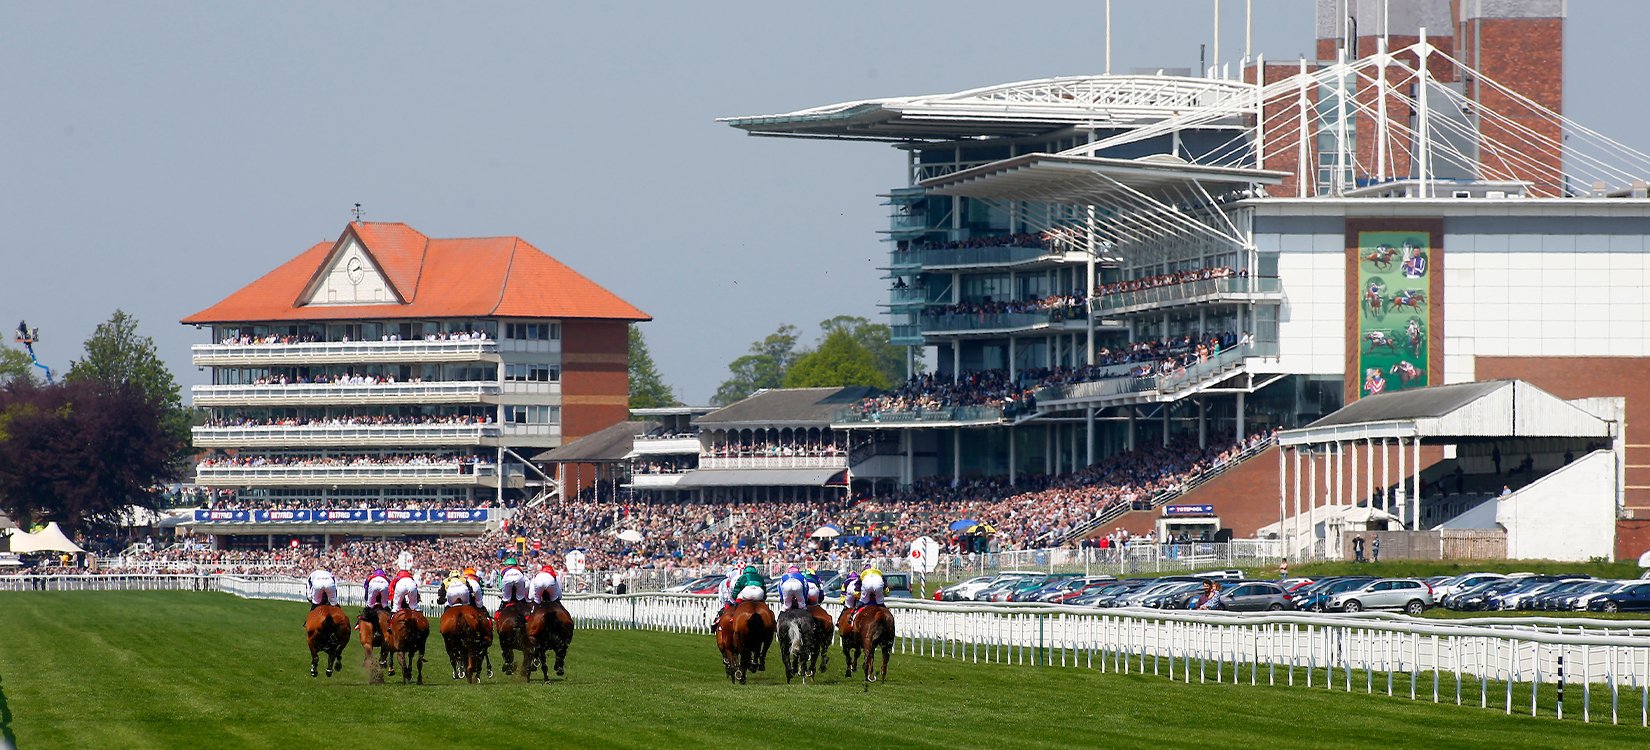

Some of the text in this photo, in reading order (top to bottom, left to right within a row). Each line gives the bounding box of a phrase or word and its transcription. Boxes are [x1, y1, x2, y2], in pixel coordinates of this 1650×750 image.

[211, 511, 233, 519] BETFRED
[270, 511, 294, 519] BETFRED
[328, 511, 351, 519] BETFRED
[387, 511, 411, 519] BETFRED
[447, 511, 470, 519] BETFRED
